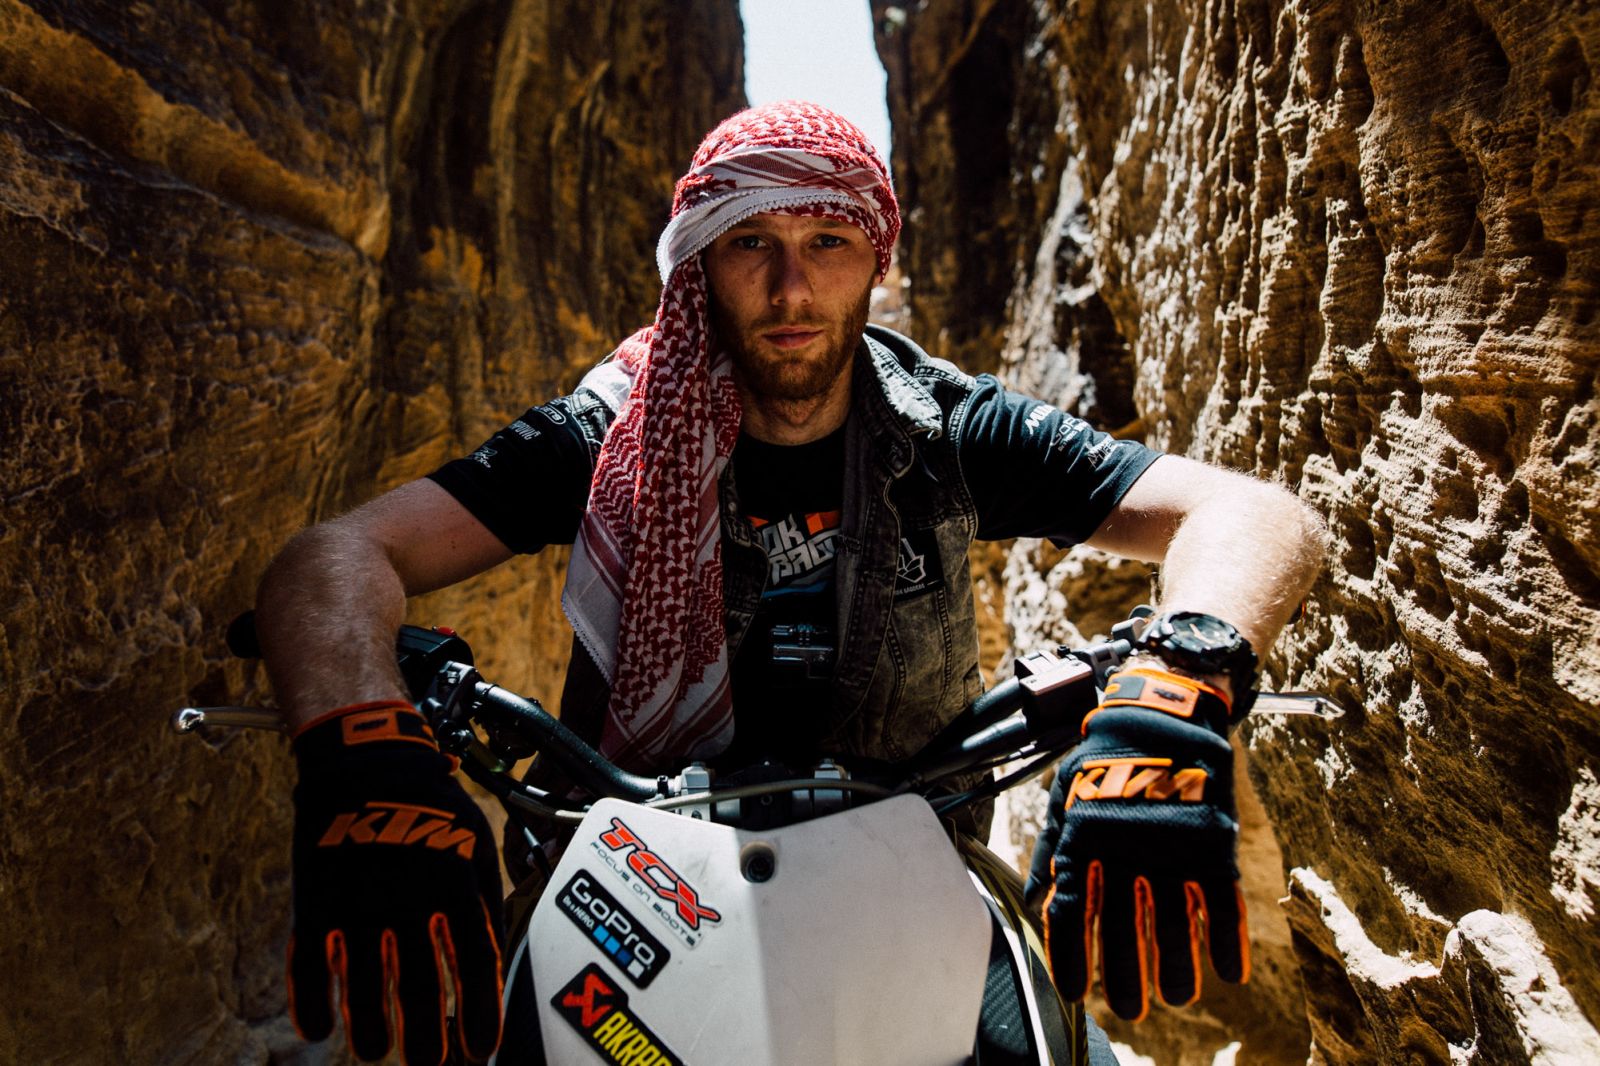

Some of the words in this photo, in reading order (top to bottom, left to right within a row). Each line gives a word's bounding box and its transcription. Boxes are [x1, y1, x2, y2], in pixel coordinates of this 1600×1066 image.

[1064, 757, 1208, 811] KTM
[318, 801, 477, 860] KTM
[599, 817, 721, 931] TCX
[571, 877, 656, 965] GoPro
[590, 841, 630, 882] FOCUS
[653, 901, 696, 947] BOOTS
